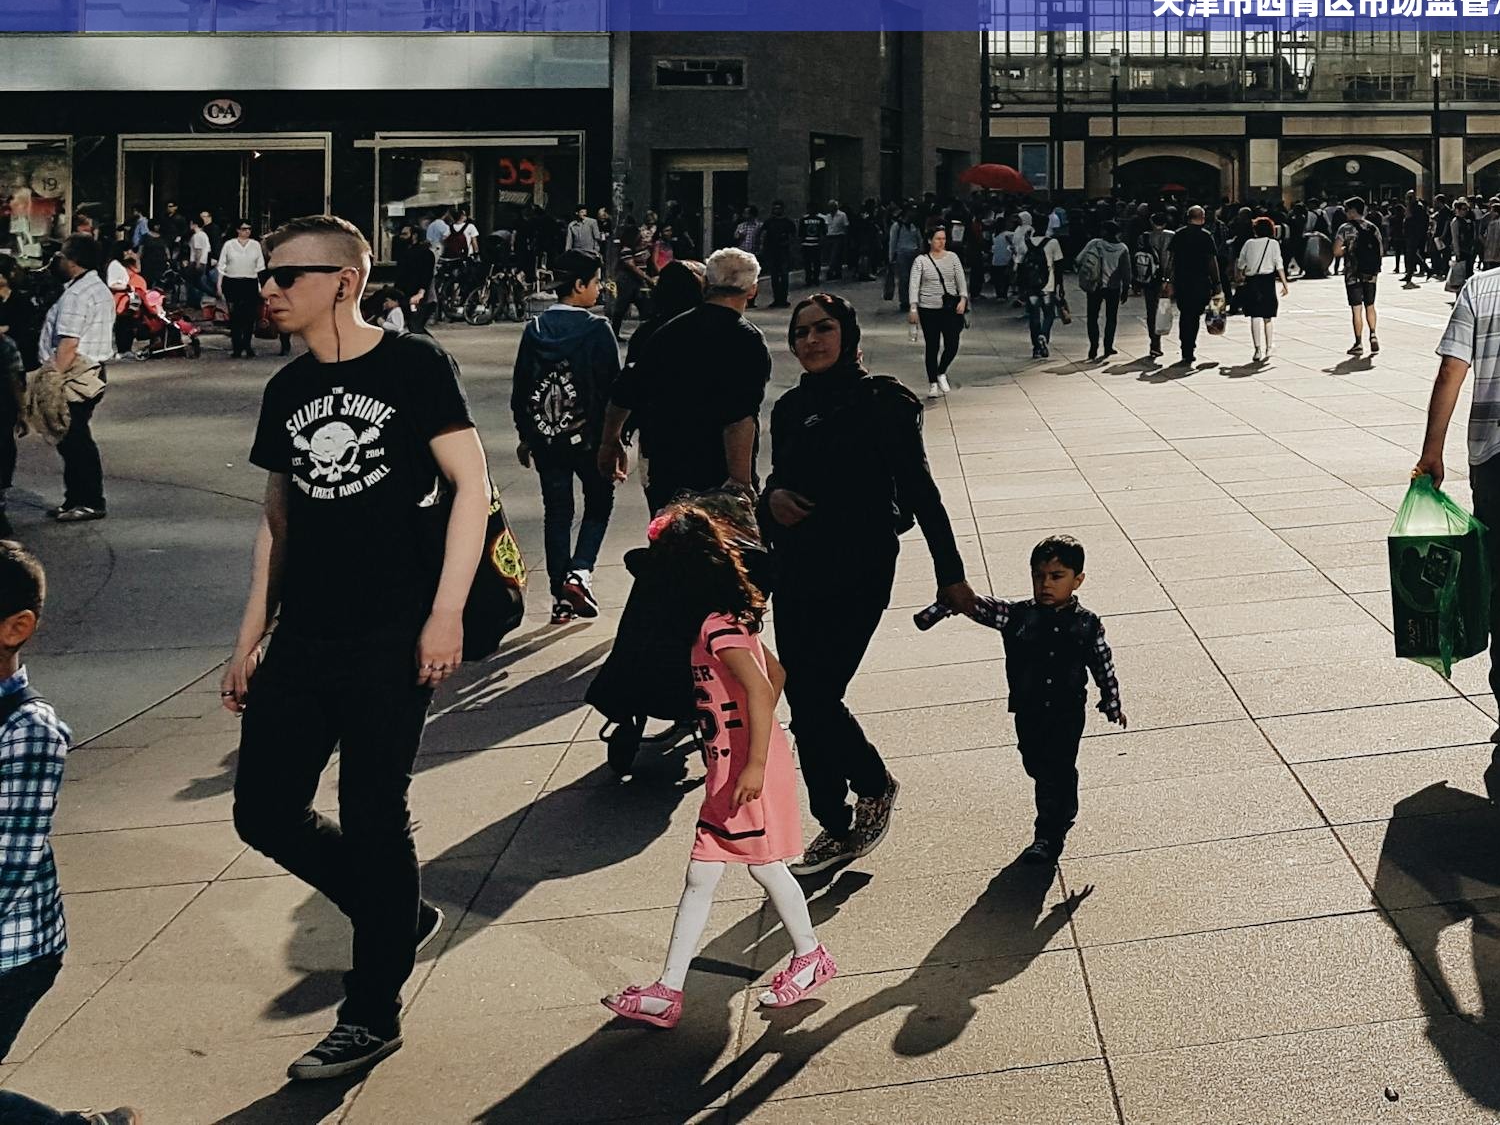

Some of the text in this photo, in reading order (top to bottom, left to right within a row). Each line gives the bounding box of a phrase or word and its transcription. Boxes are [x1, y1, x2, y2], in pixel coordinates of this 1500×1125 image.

[206, 103, 237, 119] C&A
[285, 393, 396, 437] SILVER SHINE
[365, 447, 385, 459] 2004
[339, 480, 363, 497] AND
[363, 463, 391, 487] ROLL
